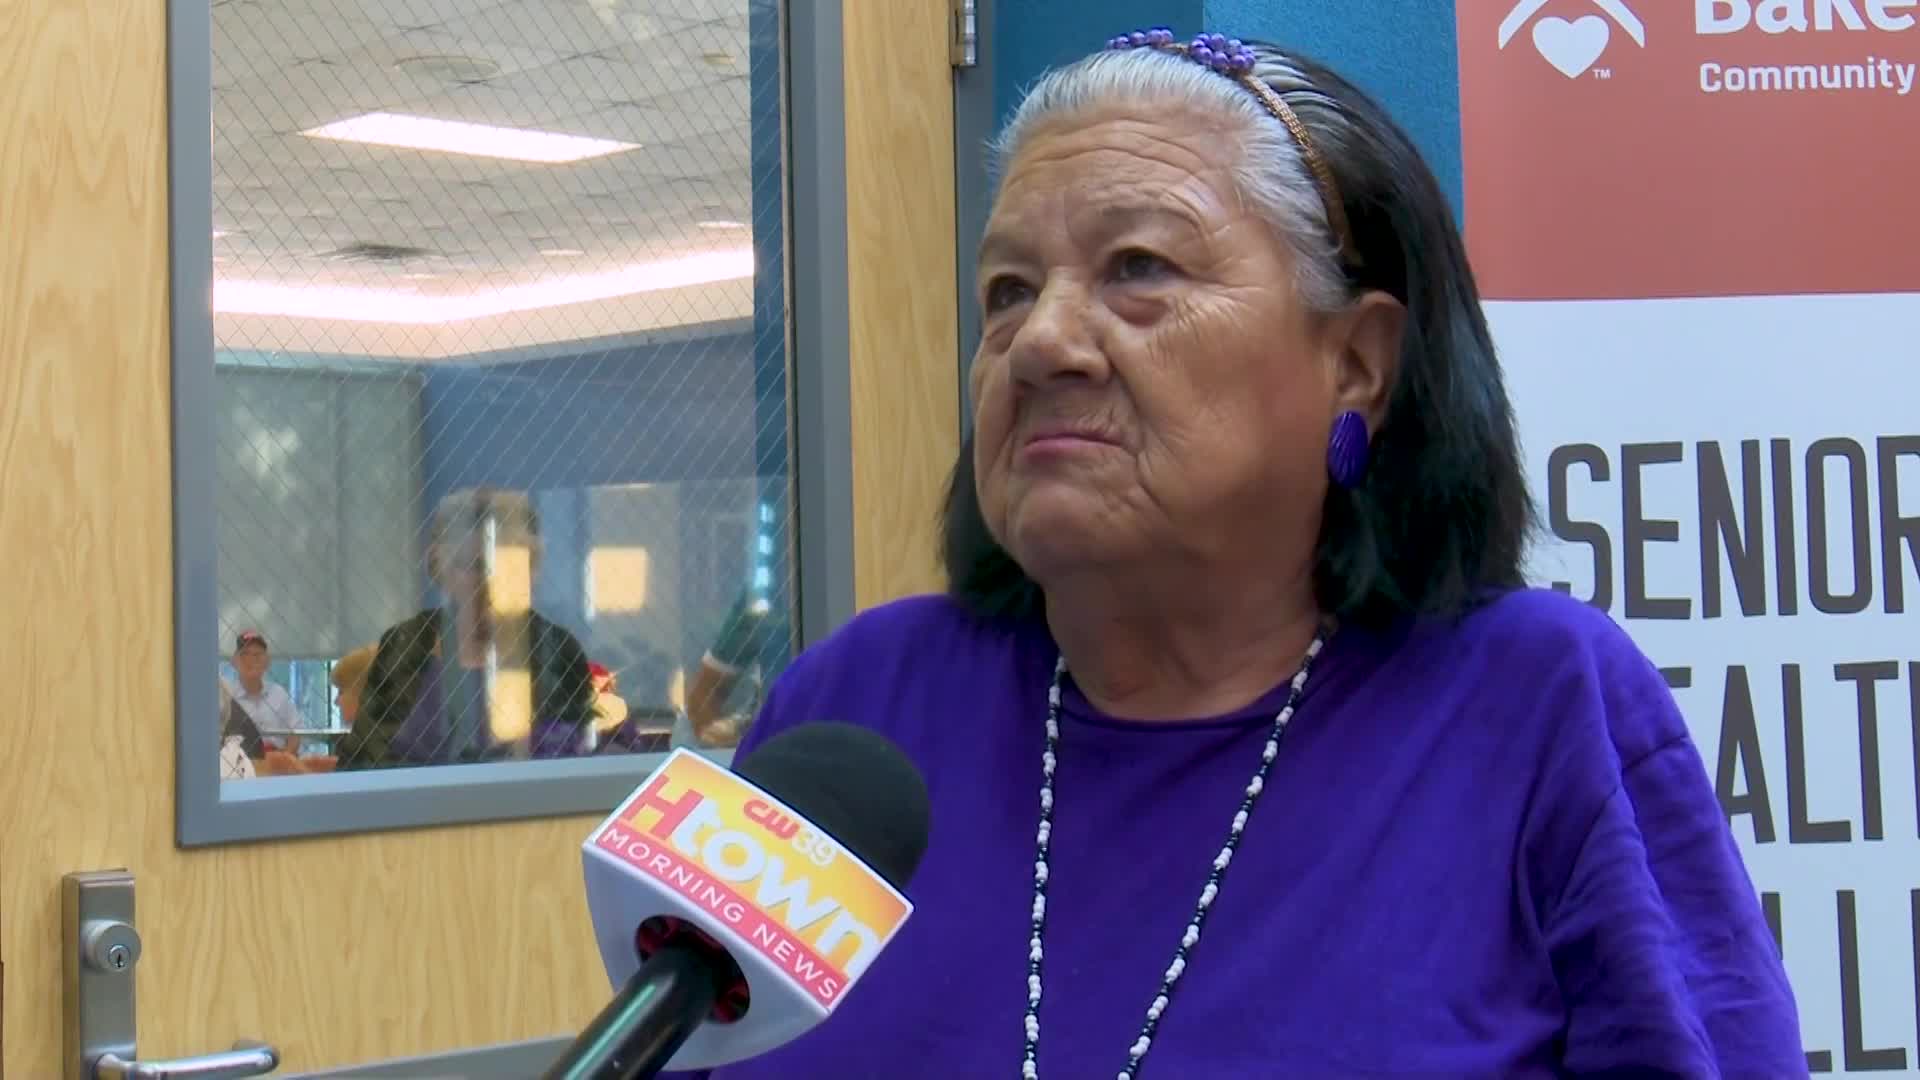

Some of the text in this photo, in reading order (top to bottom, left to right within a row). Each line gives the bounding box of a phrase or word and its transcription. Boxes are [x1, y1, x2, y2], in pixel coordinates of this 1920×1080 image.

[1699, 56, 1916, 95] Community
[1658, 660, 1920, 844] ALT
[603, 828, 839, 1000] MORNING NEWS
